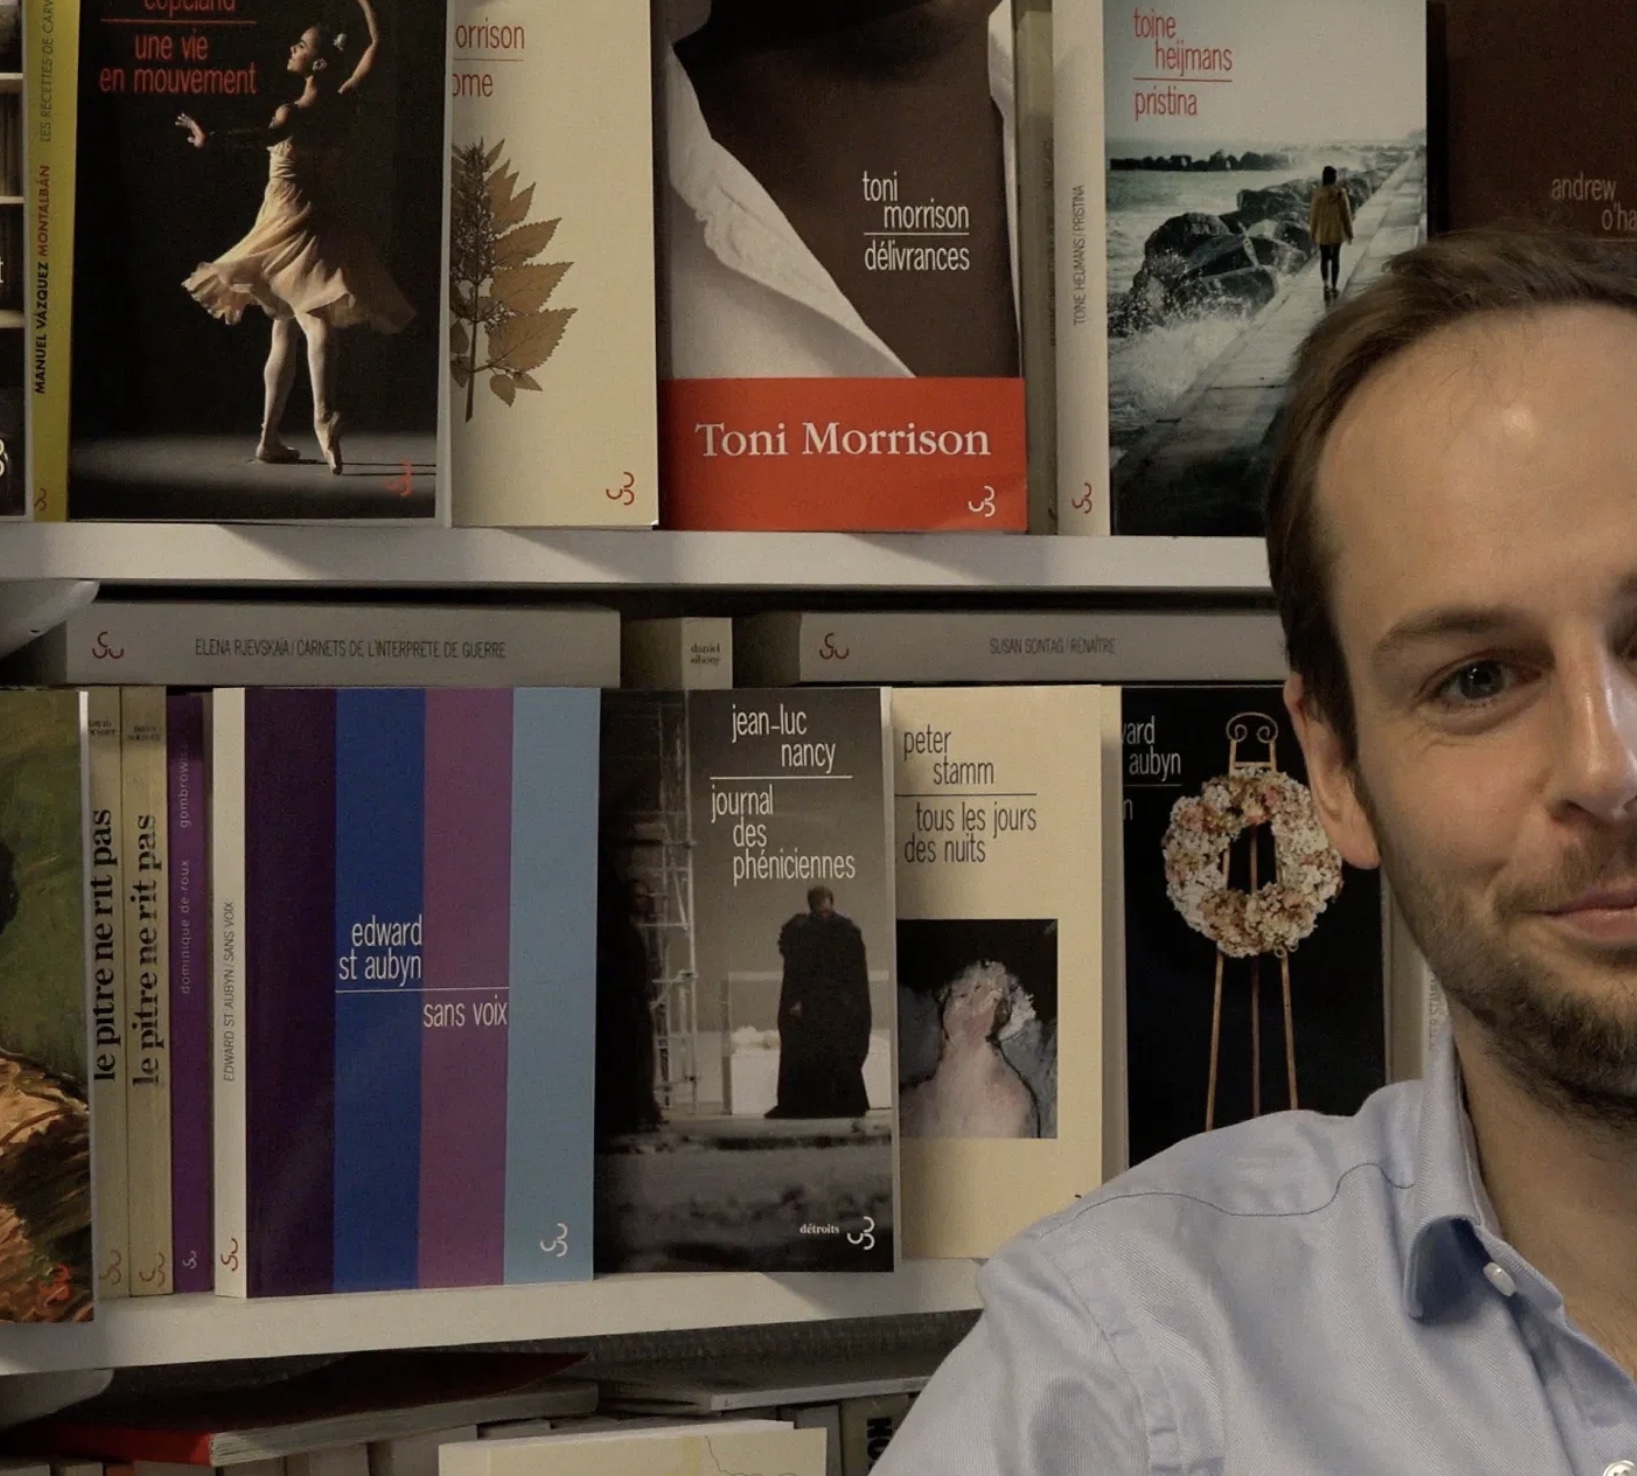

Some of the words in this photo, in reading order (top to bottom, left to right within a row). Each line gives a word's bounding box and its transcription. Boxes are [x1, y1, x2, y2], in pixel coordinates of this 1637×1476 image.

[455, 17, 525, 49] orrison
[1133, 7, 1176, 38] toine
[42, 39, 53, 54] DE
[134, 34, 172, 60] une
[181, 28, 208, 60] vie
[1155, 39, 1233, 76] heijmans
[41, 59, 53, 117] RECETTES
[100, 68, 124, 92] en
[134, 62, 257, 94] mouvement
[1134, 85, 1198, 121] pristina
[40, 123, 51, 142] LES
[862, 170, 898, 201] toni
[1551, 170, 1616, 201] andrew
[35, 165, 50, 257] MONTALBÁN
[884, 197, 969, 229] morrison
[1072, 185, 1084, 231] PRISTINA
[864, 239, 970, 271] délivrances
[33, 262, 48, 330] VÁZQUEZ
[1073, 294, 1085, 326] TOINE
[34, 334, 46, 394] MANUEL
[694, 422, 789, 456] Toni
[801, 422, 991, 456] Morrison
[195, 638, 230, 657] ELENA
[297, 638, 346, 657] CARNETS
[349, 639, 364, 657] DE
[443, 640, 458, 658] DE
[462, 640, 507, 659] GUERRE
[989, 638, 1022, 655] SUSAN
[1025, 638, 1064, 655] SONTAG
[732, 703, 807, 743] jean-luc
[781, 743, 836, 774] nancy
[904, 723, 952, 762] peter
[933, 755, 994, 785] stamm
[1129, 745, 1181, 782] aubyn
[711, 783, 774, 824] journal
[916, 801, 955, 832] tous
[962, 801, 986, 832] les
[993, 801, 1037, 839] jours
[92, 809, 118, 866] pas
[136, 814, 162, 872] pas
[733, 815, 767, 847] des
[904, 832, 937, 863] des
[944, 832, 986, 863] nuits
[180, 860, 190, 891] roux
[733, 847, 856, 887] phéniciennes
[90, 874, 113, 916] rit
[130, 880, 157, 920] rit
[179, 897, 190, 913] de
[223, 903, 234, 927] VOIX
[352, 914, 422, 947] edward
[94, 924, 114, 960] ne
[137, 928, 159, 965] ne
[180, 919, 192, 994] dominique
[339, 948, 358, 981] st
[364, 947, 421, 987] aubyn
[92, 969, 120, 1045] pitre
[131, 972, 164, 1050] pitre
[223, 1012, 234, 1027] ST
[423, 1002, 466, 1028] sans
[473, 994, 508, 1026] voix
[93, 1054, 115, 1081] le
[132, 1058, 159, 1086] le
[223, 1031, 234, 1081] EDWARD
[799, 1223, 840, 1235] détroits
